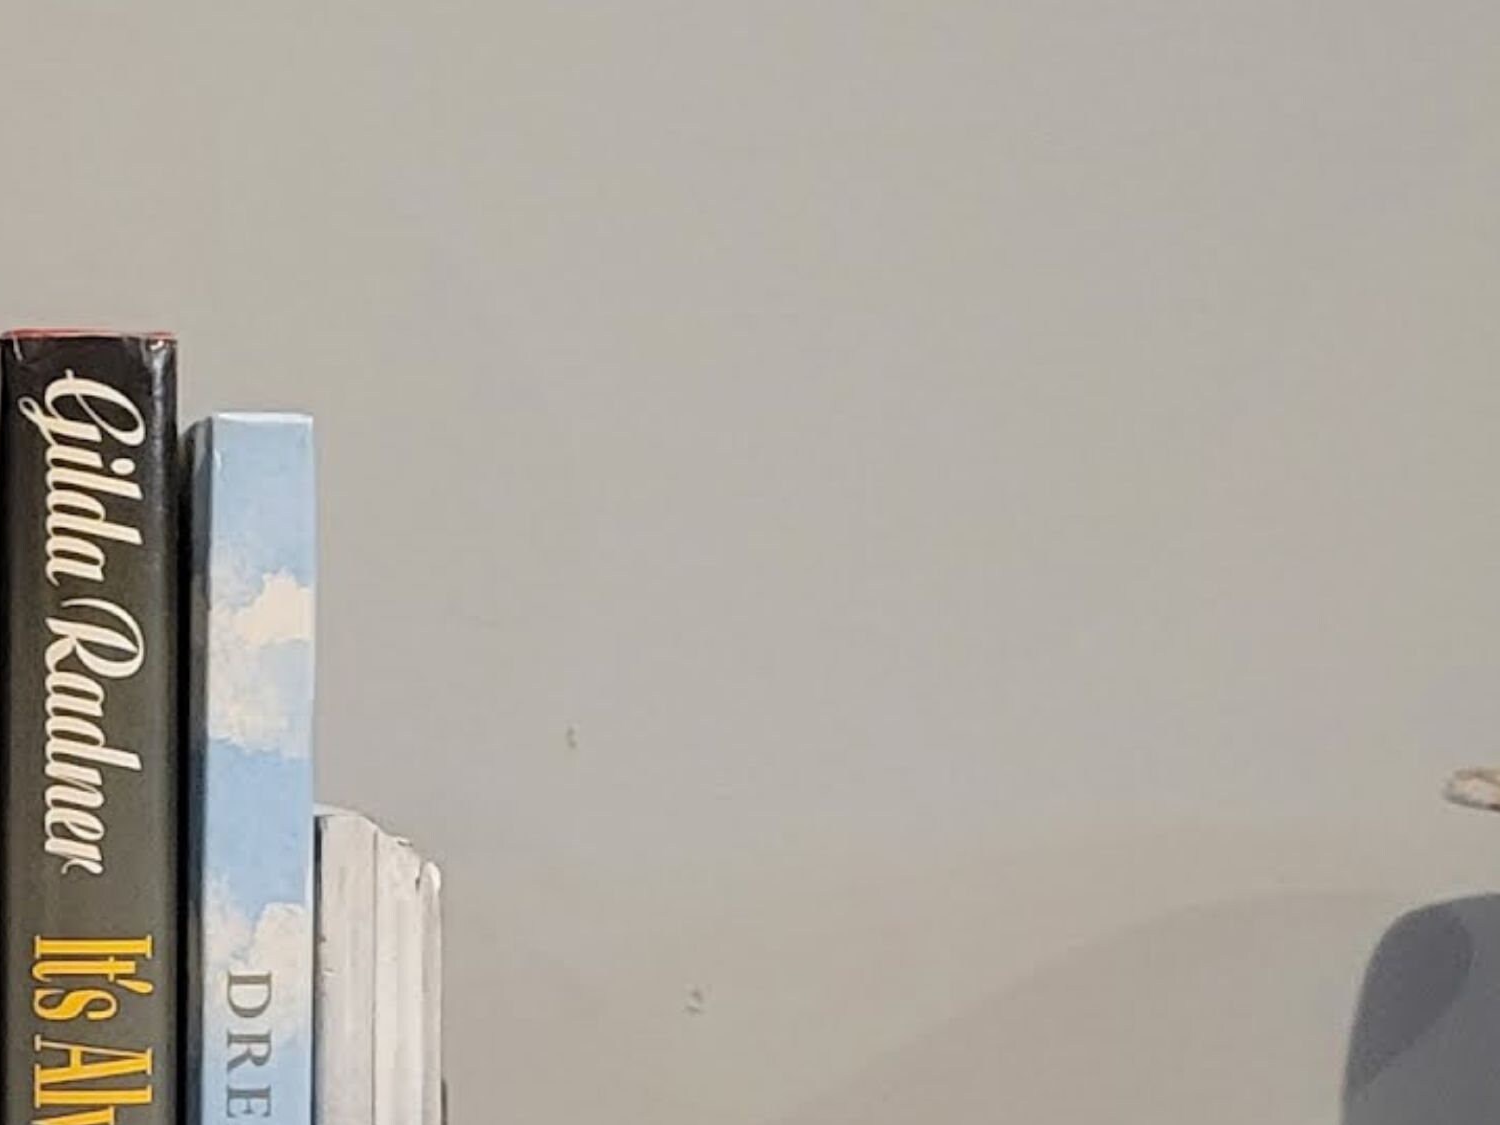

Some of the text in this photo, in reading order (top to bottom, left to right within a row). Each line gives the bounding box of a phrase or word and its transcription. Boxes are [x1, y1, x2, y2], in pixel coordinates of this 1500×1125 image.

[18, 368, 147, 875] Gilda Radner
[30, 934, 155, 1021] It's
